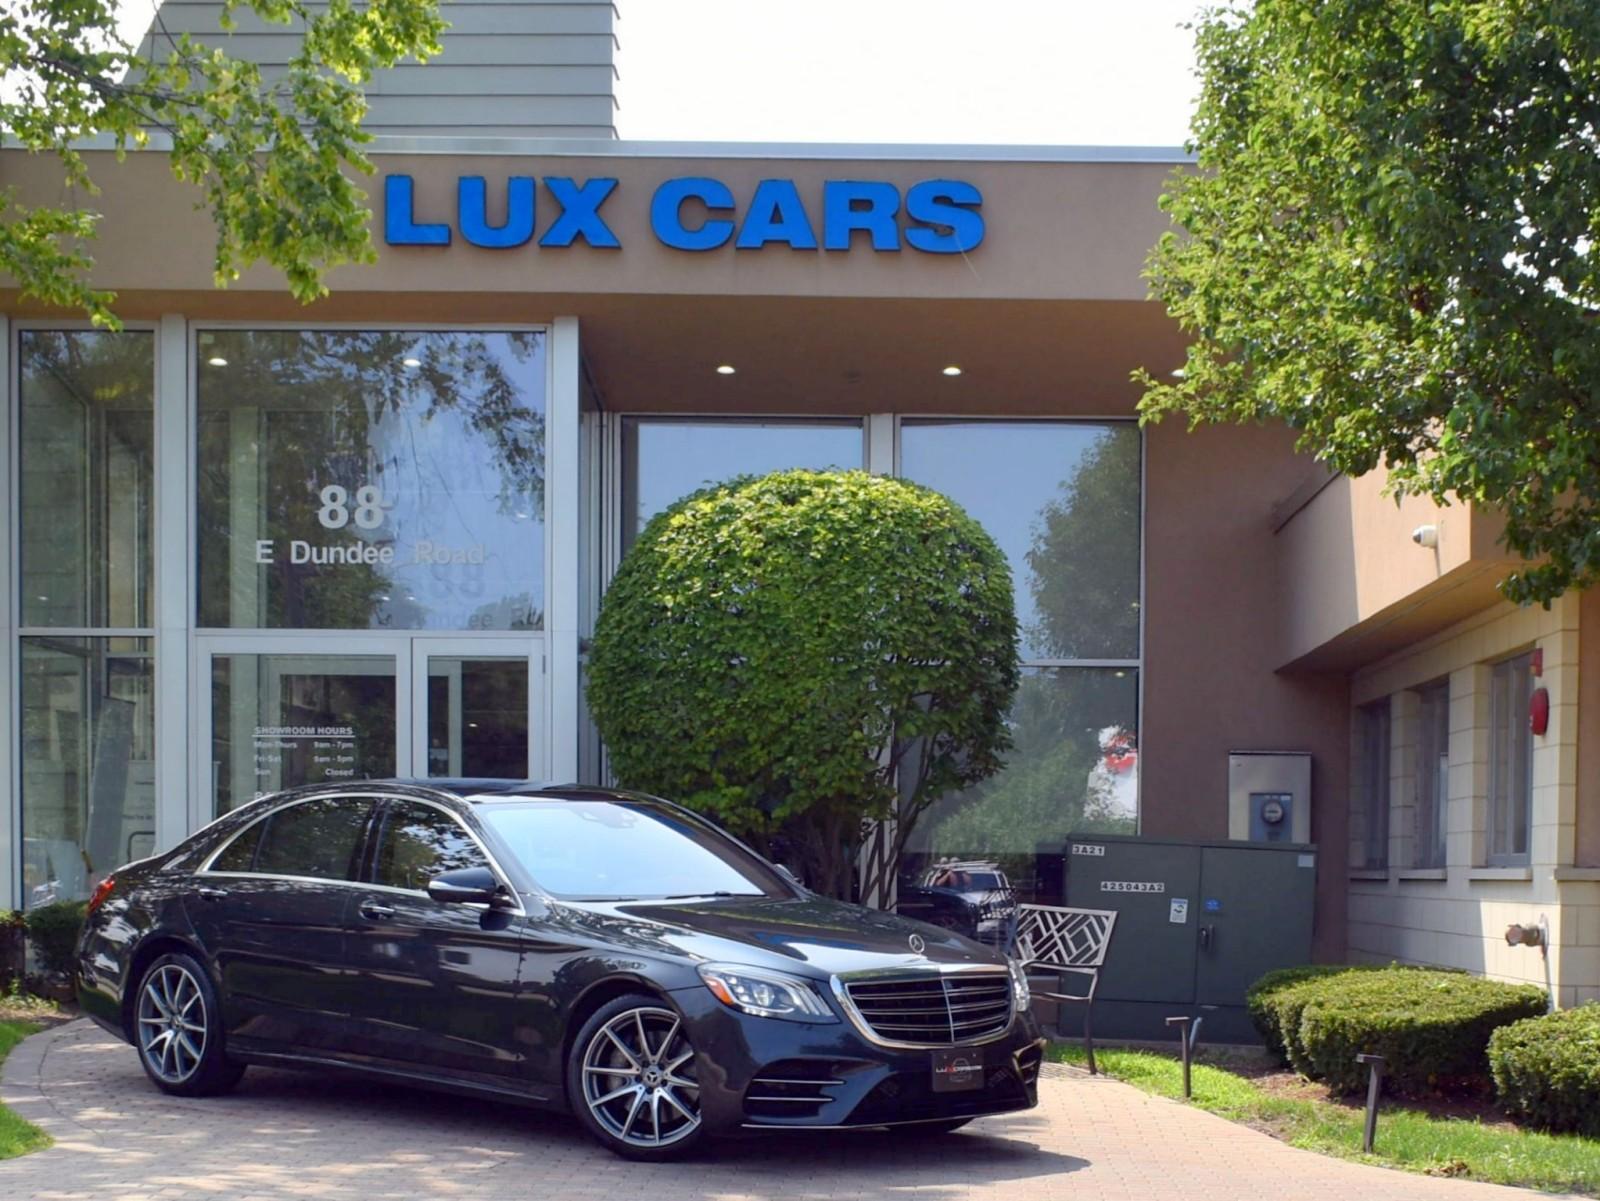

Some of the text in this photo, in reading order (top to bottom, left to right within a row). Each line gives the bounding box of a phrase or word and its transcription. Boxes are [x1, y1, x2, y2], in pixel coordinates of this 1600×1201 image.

[384, 174, 985, 254] LUX CARS
[318, 485, 386, 529] 88
[255, 540, 485, 565] E Dundee Road
[254, 726, 353, 735] SHOWROOM HOURS
[324, 767, 354, 776] Closed
[1073, 845, 1104, 856] 3A21
[1101, 882, 1164, 892] 425043A2
